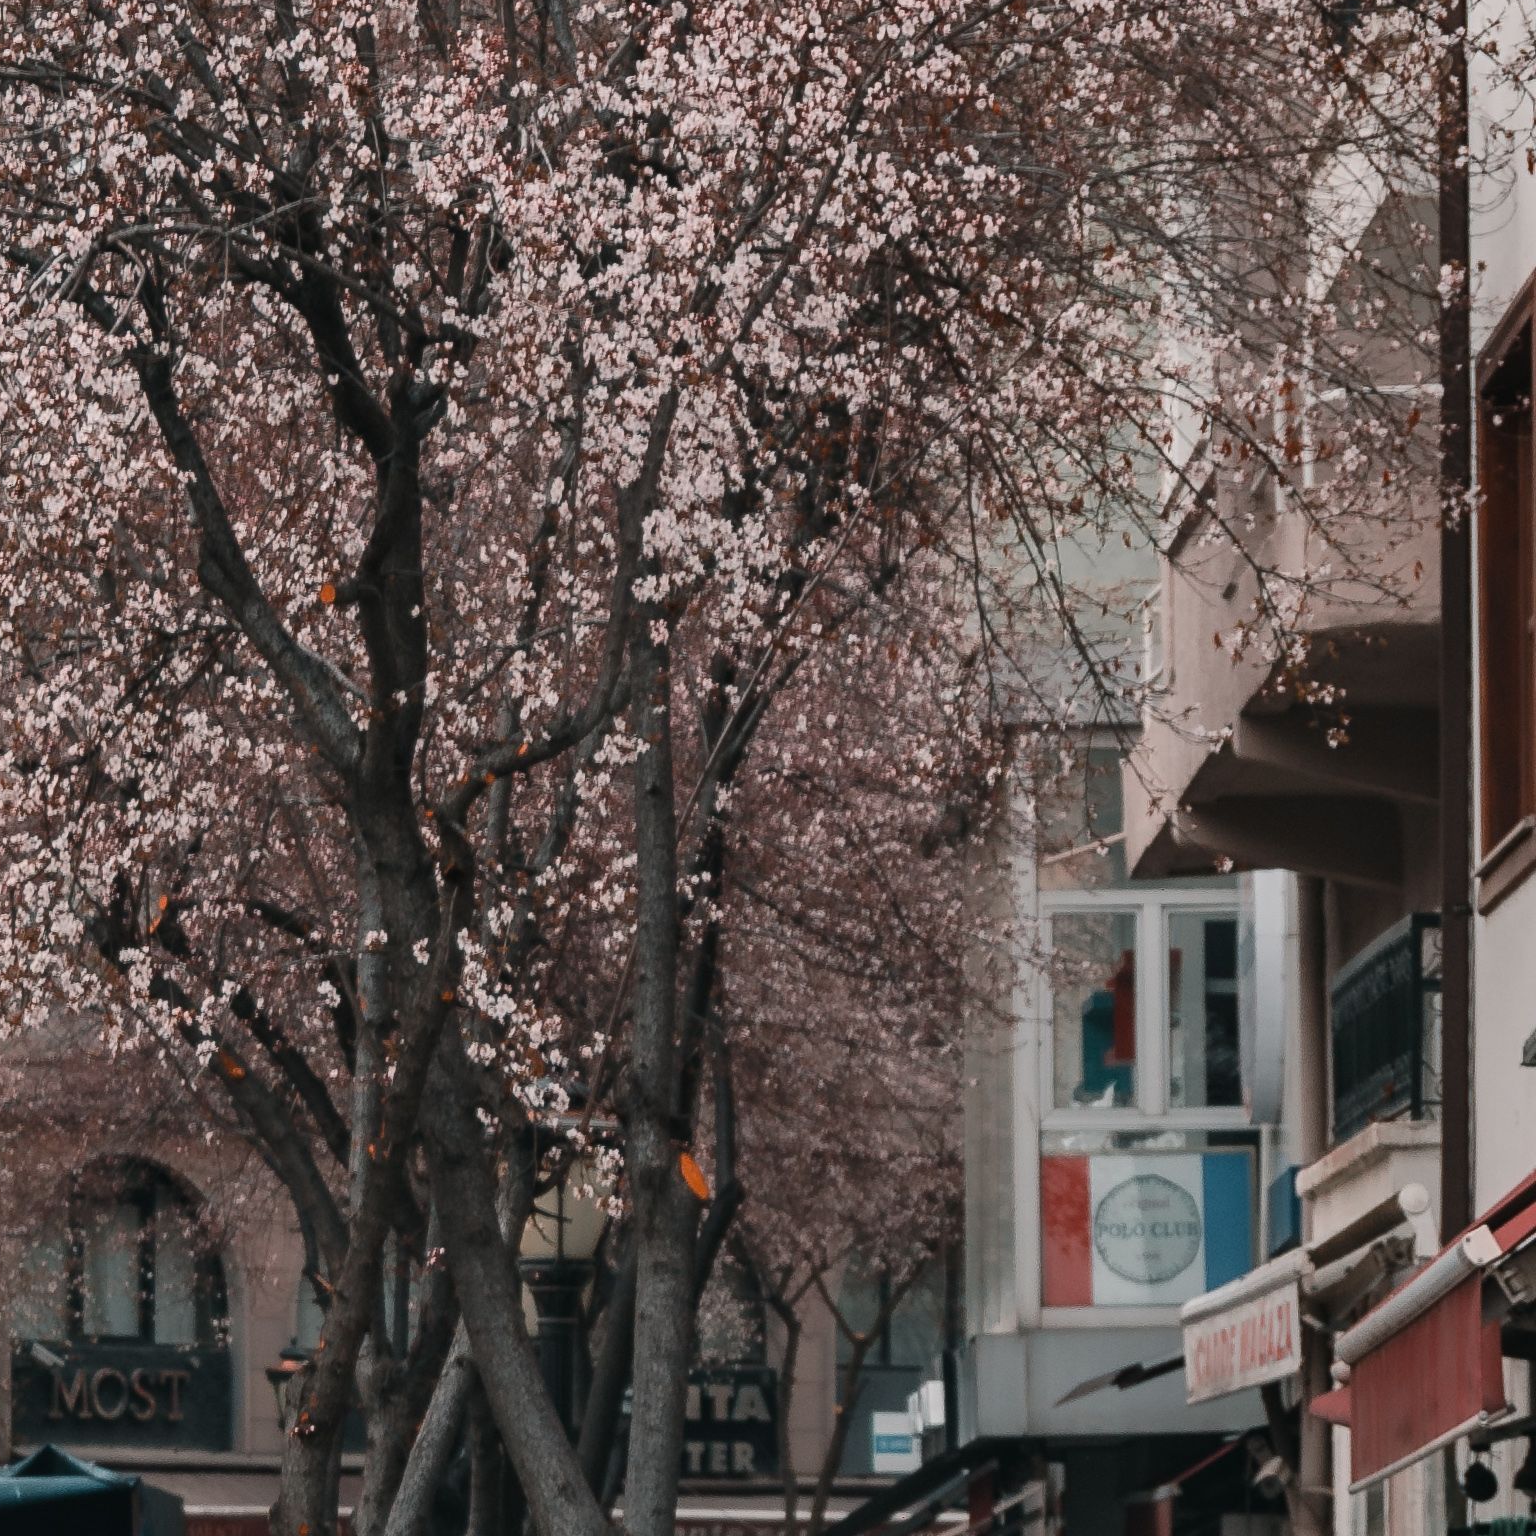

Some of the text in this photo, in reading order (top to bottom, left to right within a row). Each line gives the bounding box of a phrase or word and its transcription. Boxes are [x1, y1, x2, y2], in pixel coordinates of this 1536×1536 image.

[1097, 1221, 1201, 1240] POLO CLUB
[48, 1367, 192, 1421] MOST
[686, 1441, 755, 1473] TER
